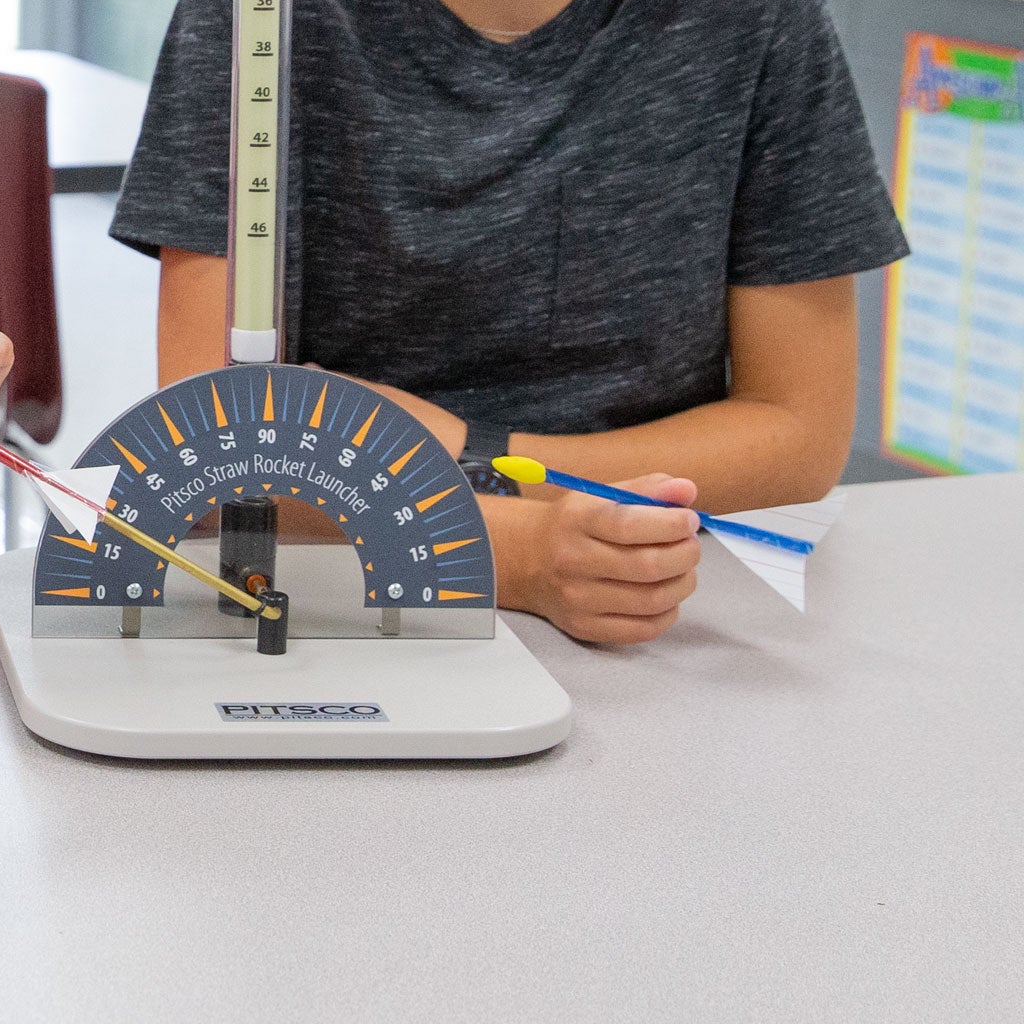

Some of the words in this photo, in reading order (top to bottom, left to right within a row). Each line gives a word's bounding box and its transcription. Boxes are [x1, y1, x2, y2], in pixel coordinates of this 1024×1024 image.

[255, 41, 272, 52] 38
[254, 86, 271, 97] 40
[252, 132, 269, 143] 42
[251, 177, 268, 188] 44
[250, 222, 267, 233] 46
[218, 431, 237, 451] 75
[257, 428, 277, 444] 90
[299, 431, 318, 452] 75
[178, 447, 199, 467] 60
[338, 447, 357, 468] 60
[145, 472, 166, 491] 45
[160, 477, 206, 515] Pitsco
[203, 460, 249, 486] Straw
[253, 453, 307, 478] Rocket
[306, 461, 371, 515] Launcher
[370, 472, 389, 492] 45
[117, 503, 139, 524] 30
[393, 506, 415, 526] 30
[103, 543, 122, 560] 15
[409, 544, 428, 562] 15
[96, 584, 106, 601] 0
[422, 586, 433, 603] 0
[221, 705, 381, 715] PITSCO
